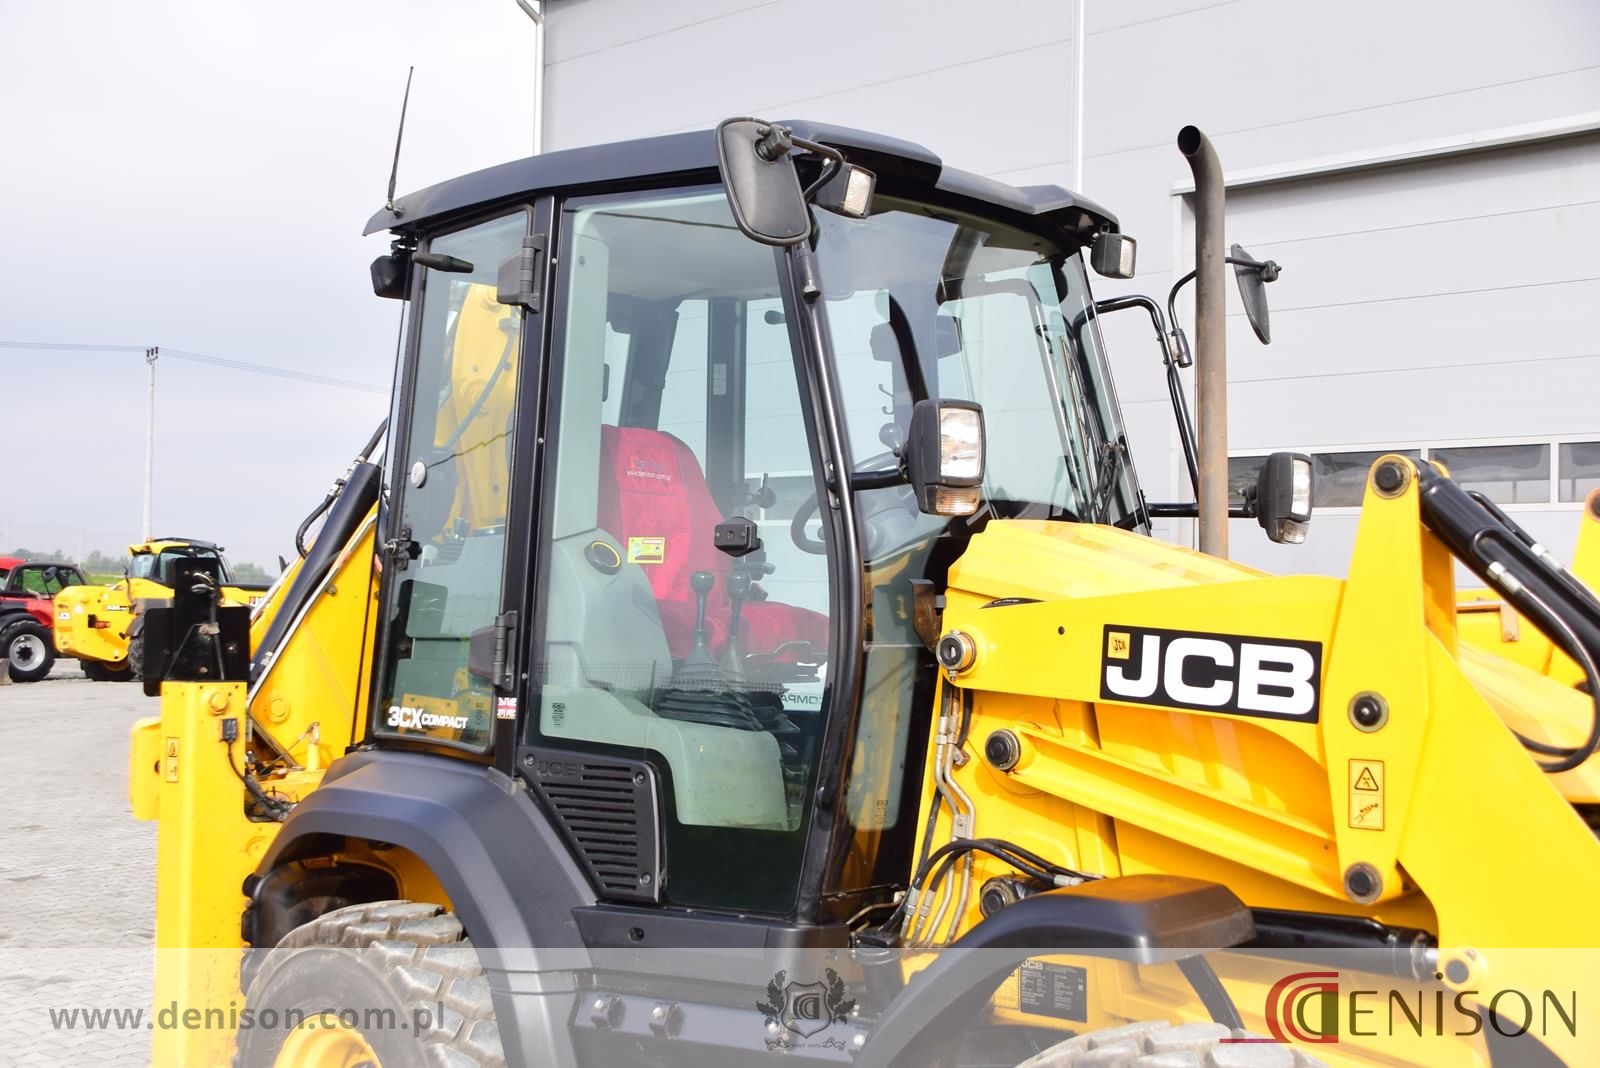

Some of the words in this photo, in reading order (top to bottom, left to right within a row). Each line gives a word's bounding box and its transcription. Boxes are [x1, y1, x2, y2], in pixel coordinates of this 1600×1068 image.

[1106, 634, 1315, 715] JCB
[388, 706, 423, 728] 3CX
[421, 713, 468, 729] COMPACT
[1021, 960, 1043, 970] JCB
